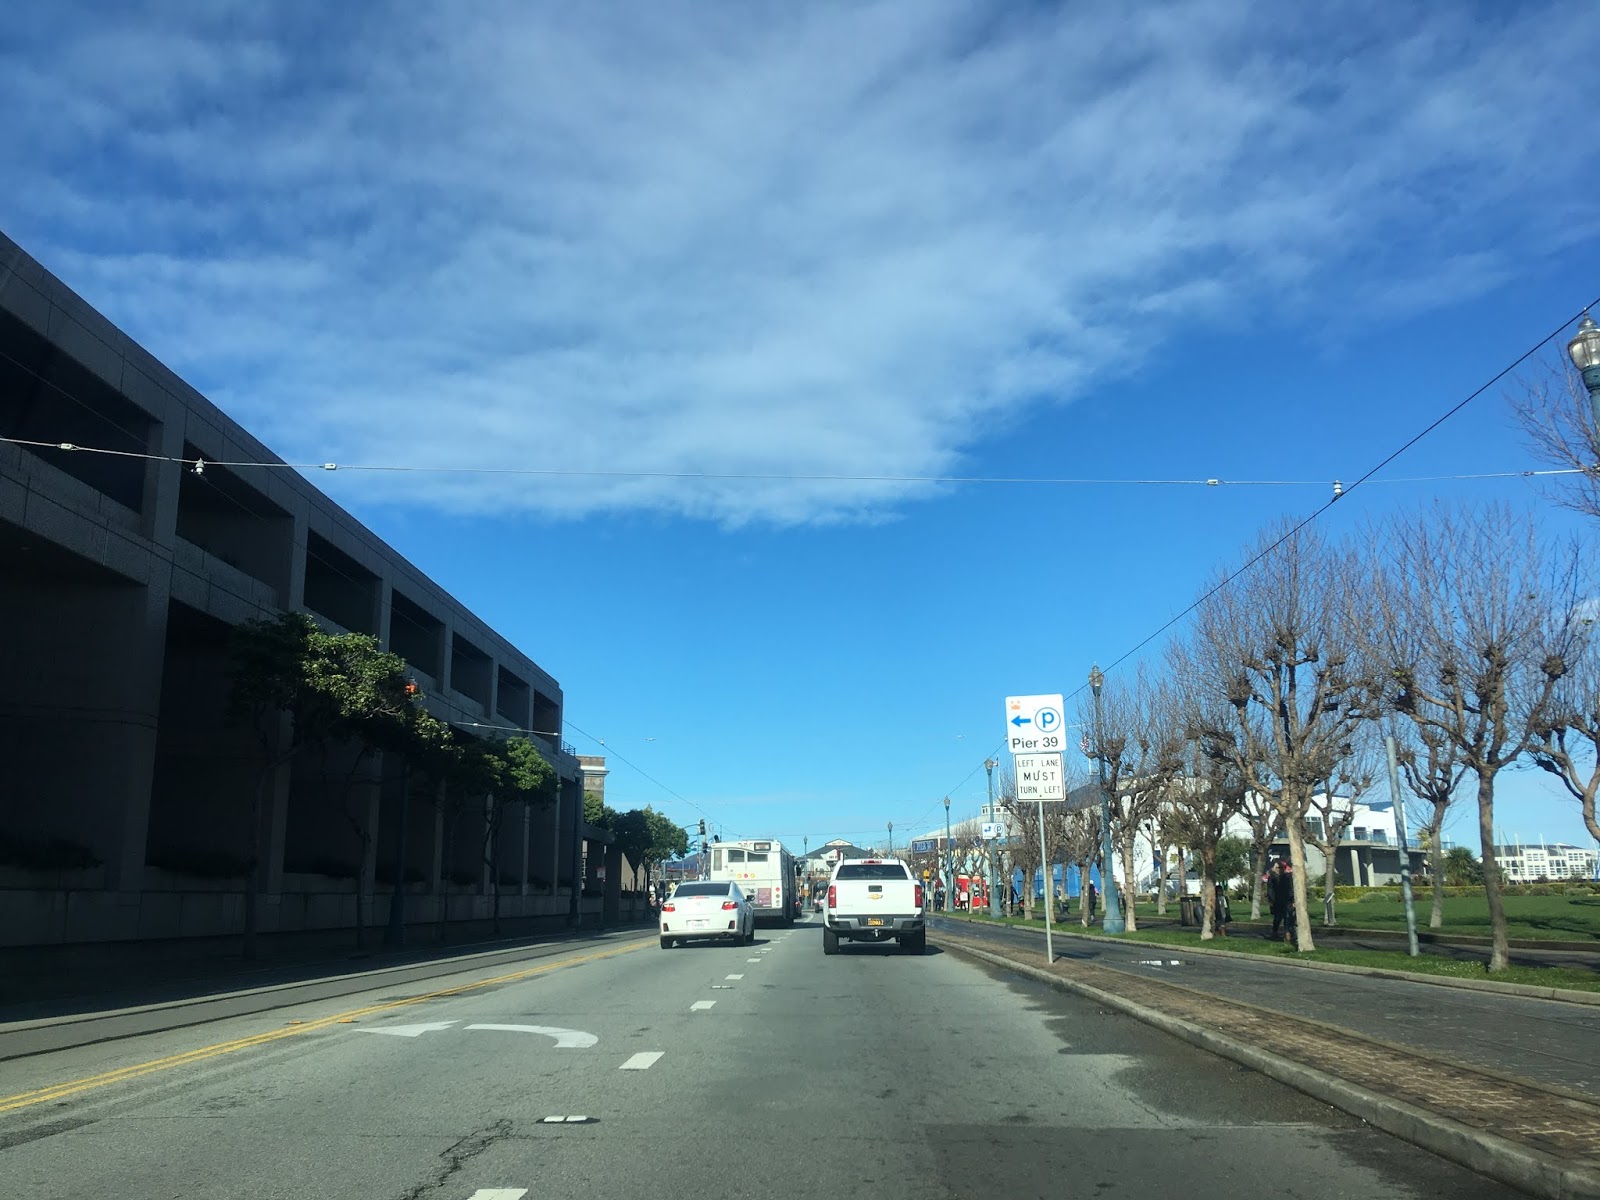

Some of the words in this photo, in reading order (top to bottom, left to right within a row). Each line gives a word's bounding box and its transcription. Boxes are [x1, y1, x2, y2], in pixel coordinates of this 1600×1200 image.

[1012, 738, 1039, 749] Pier
[1042, 737, 1058, 748] 39
[1018, 760, 1034, 768] LEFT
[1041, 759, 1059, 767] LANE
[1023, 771, 1055, 781] MUST
[1020, 786, 1038, 794] TURN
[1044, 785, 1061, 793] LEFT
